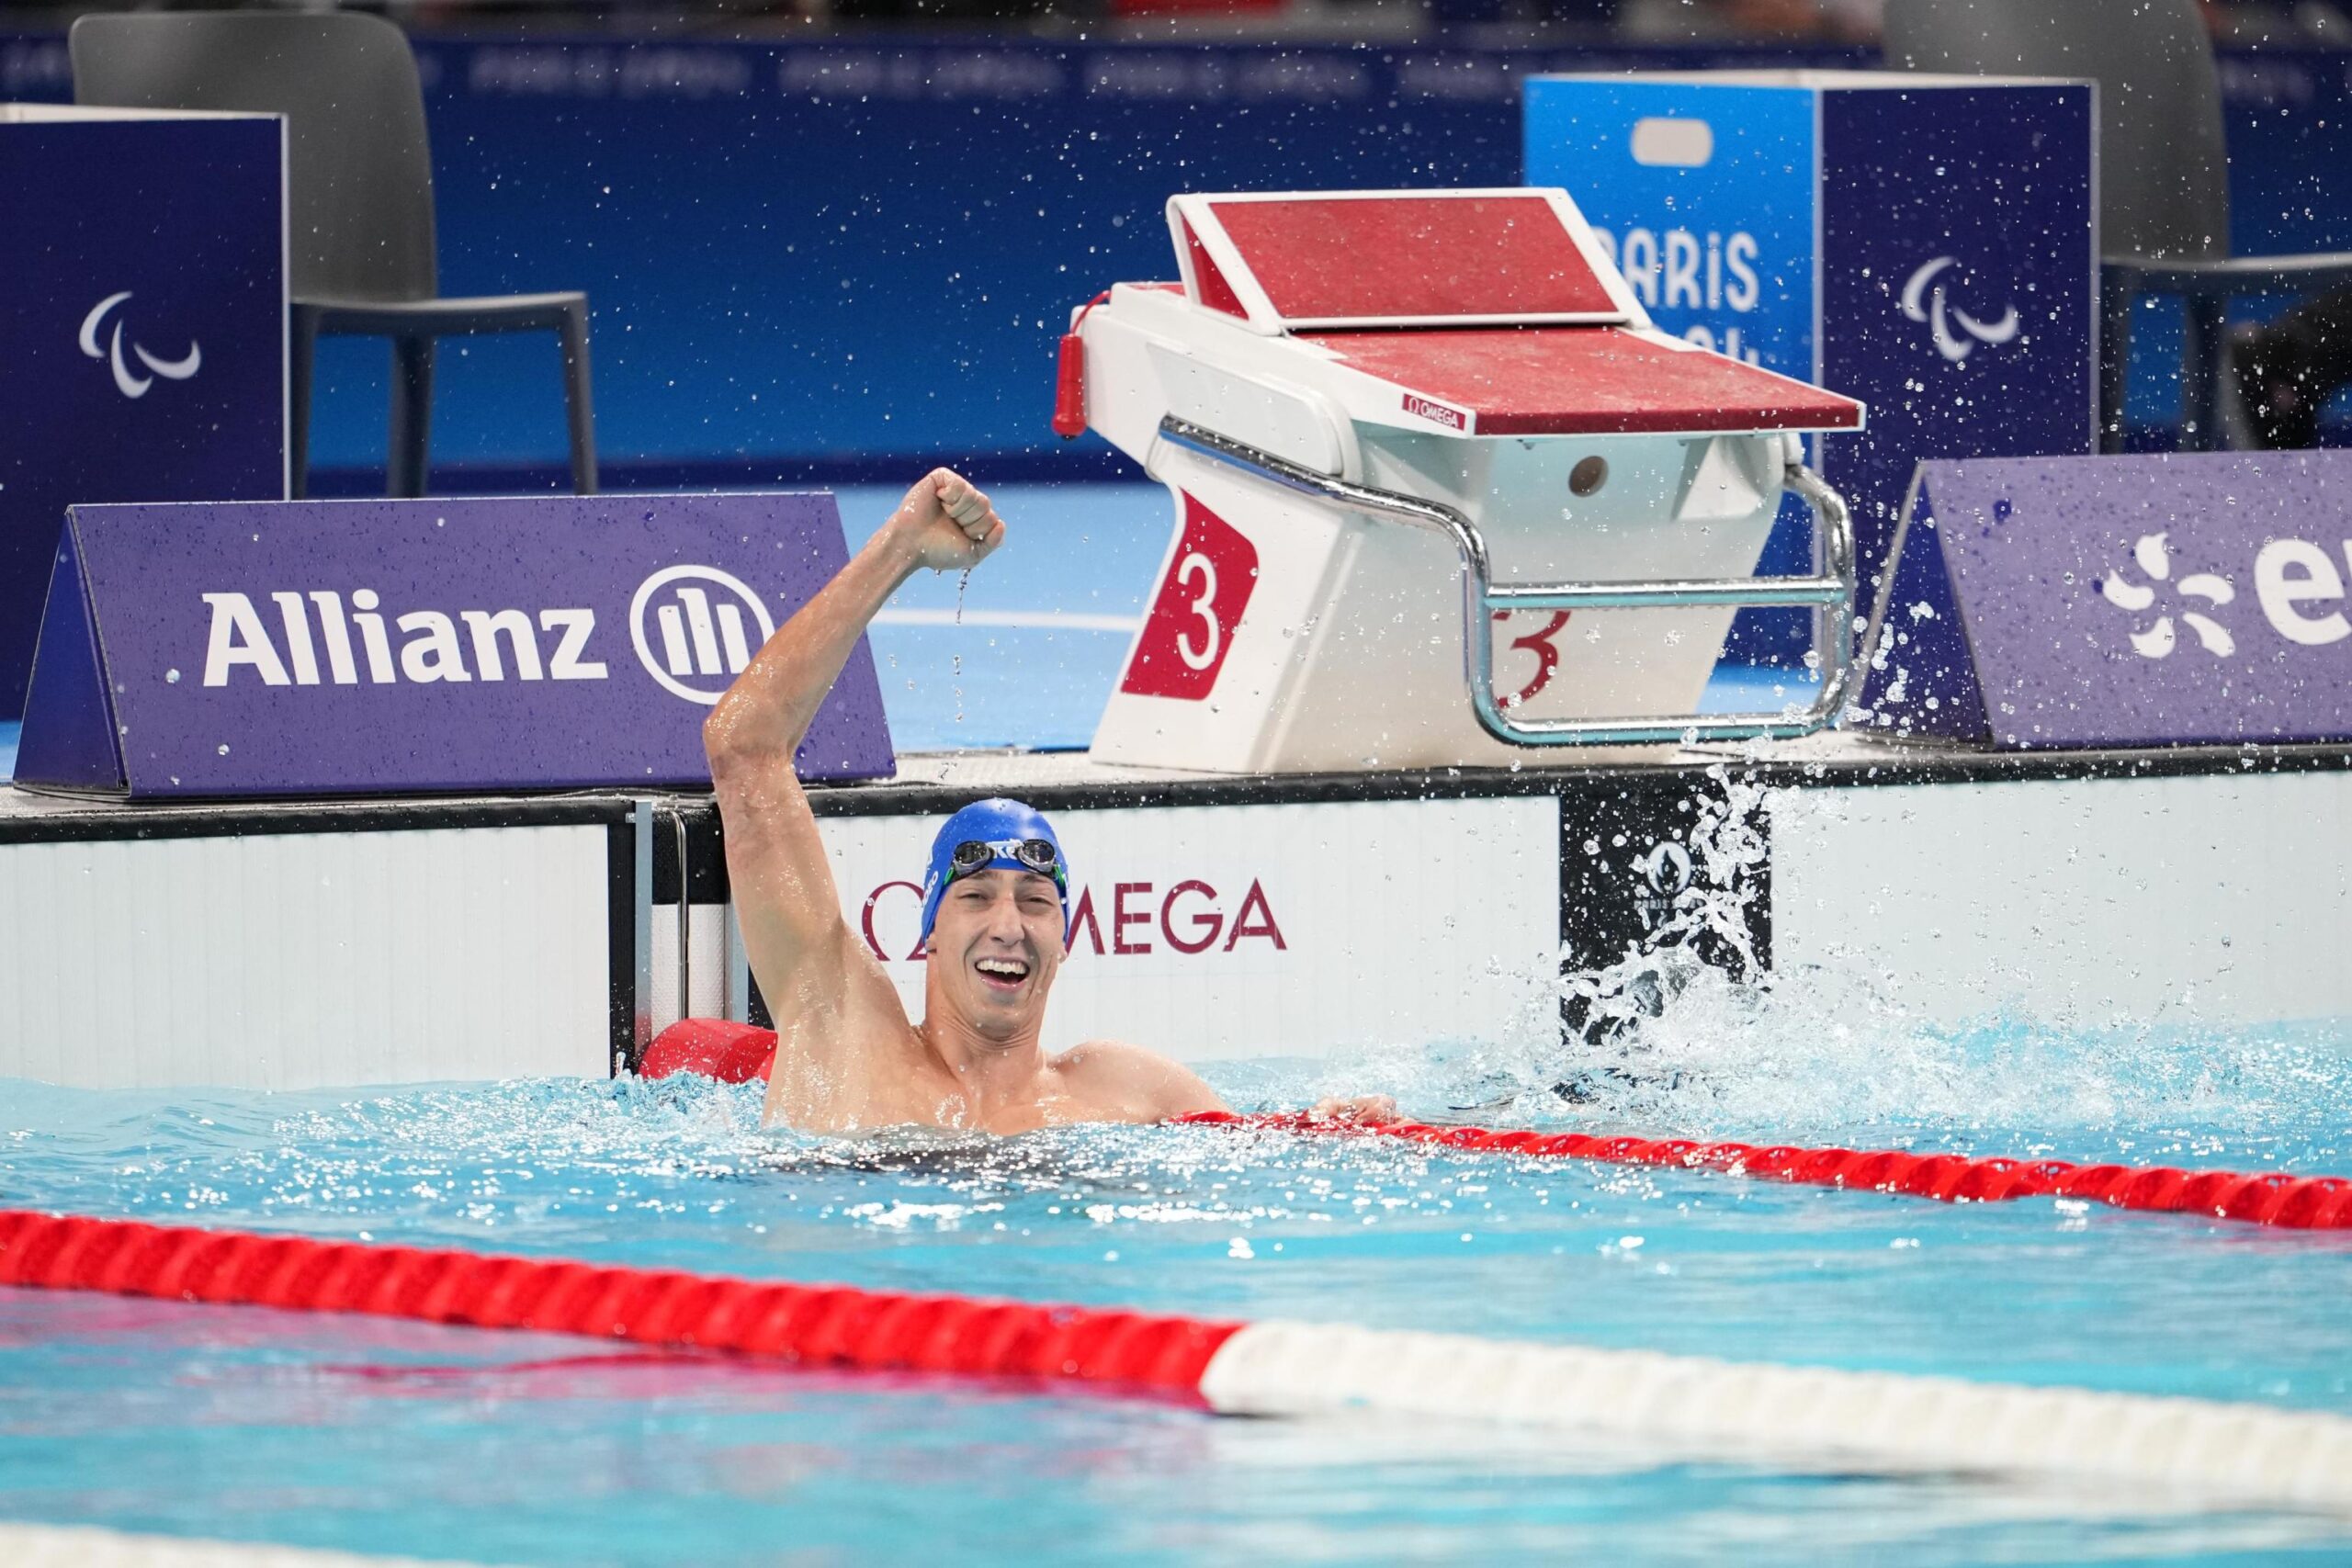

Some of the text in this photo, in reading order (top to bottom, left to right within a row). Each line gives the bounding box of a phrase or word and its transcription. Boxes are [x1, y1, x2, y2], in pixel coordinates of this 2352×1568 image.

[1420, 402, 1460, 429] OMEGA
[201, 588, 608, 687] Allianz
[1177, 552, 1219, 671] 3
[2254, 537, 2352, 646] e
[1492, 608, 1572, 709] 3
